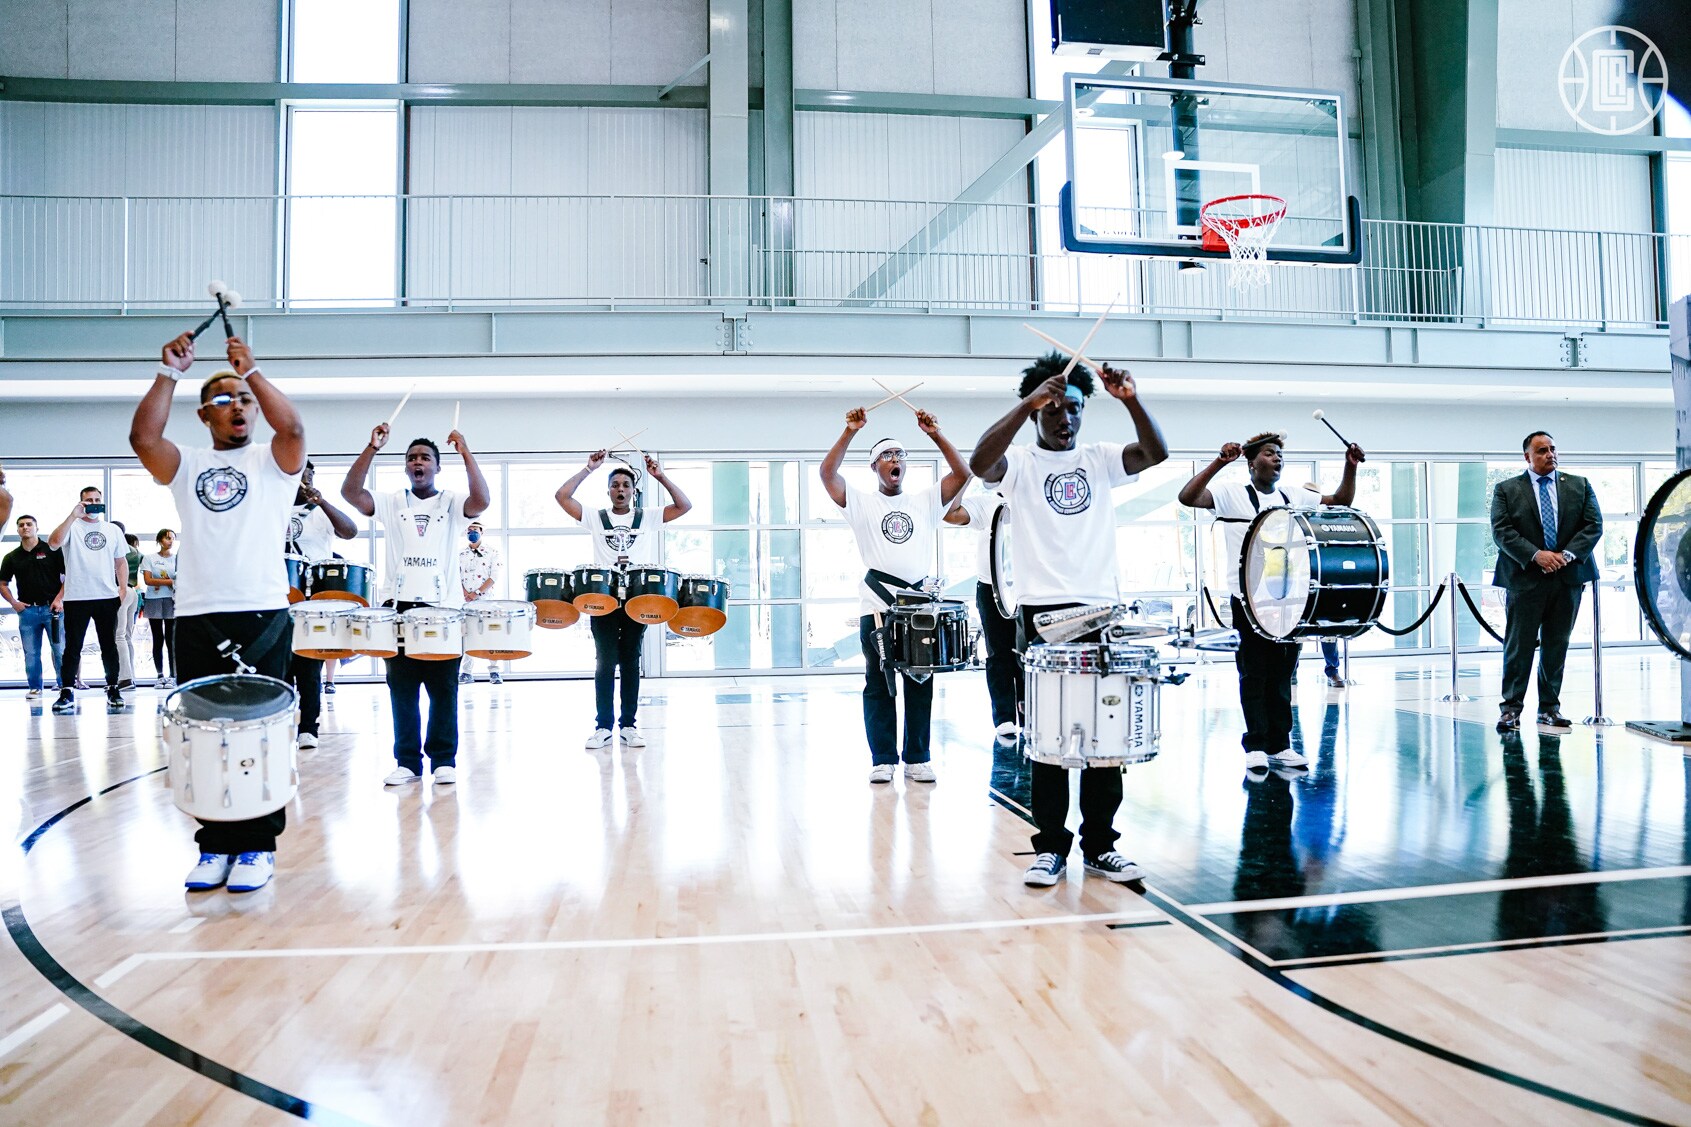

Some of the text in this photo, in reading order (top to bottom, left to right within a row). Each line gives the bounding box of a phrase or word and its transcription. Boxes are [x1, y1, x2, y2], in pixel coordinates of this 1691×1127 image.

[1329, 524, 1357, 533] YAMAHA
[403, 557, 437, 567] YAMAHA
[877, 638, 886, 660] YAMAHA
[1134, 700, 1143, 748] YAMAHA
